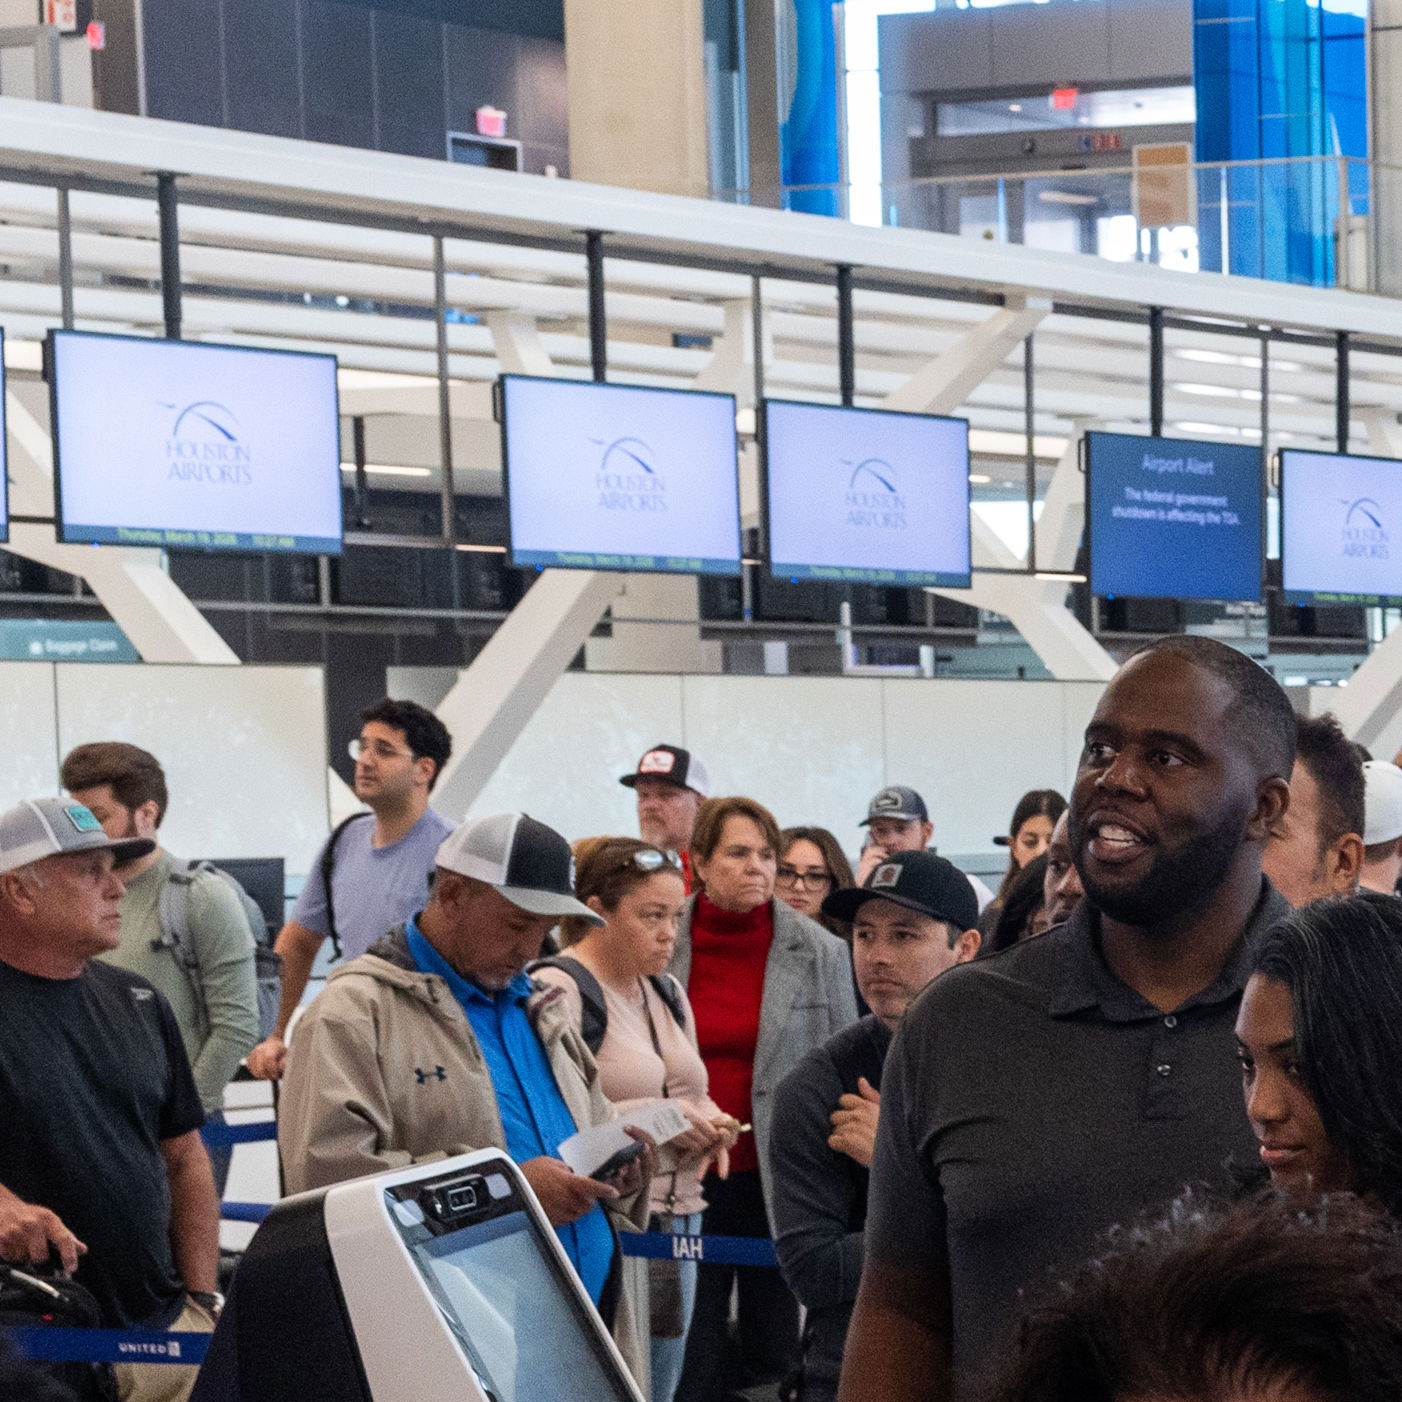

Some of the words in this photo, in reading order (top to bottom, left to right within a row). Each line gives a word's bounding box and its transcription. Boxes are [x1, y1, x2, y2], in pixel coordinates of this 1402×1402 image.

[166, 440, 251, 463] HOUSTON
[167, 463, 253, 485] AIRPORTS
[1142, 453, 1184, 475] Airport
[1186, 457, 1214, 476] Alert
[672, 1236, 704, 1260] IAH
[118, 1342, 167, 1354] UNITED
